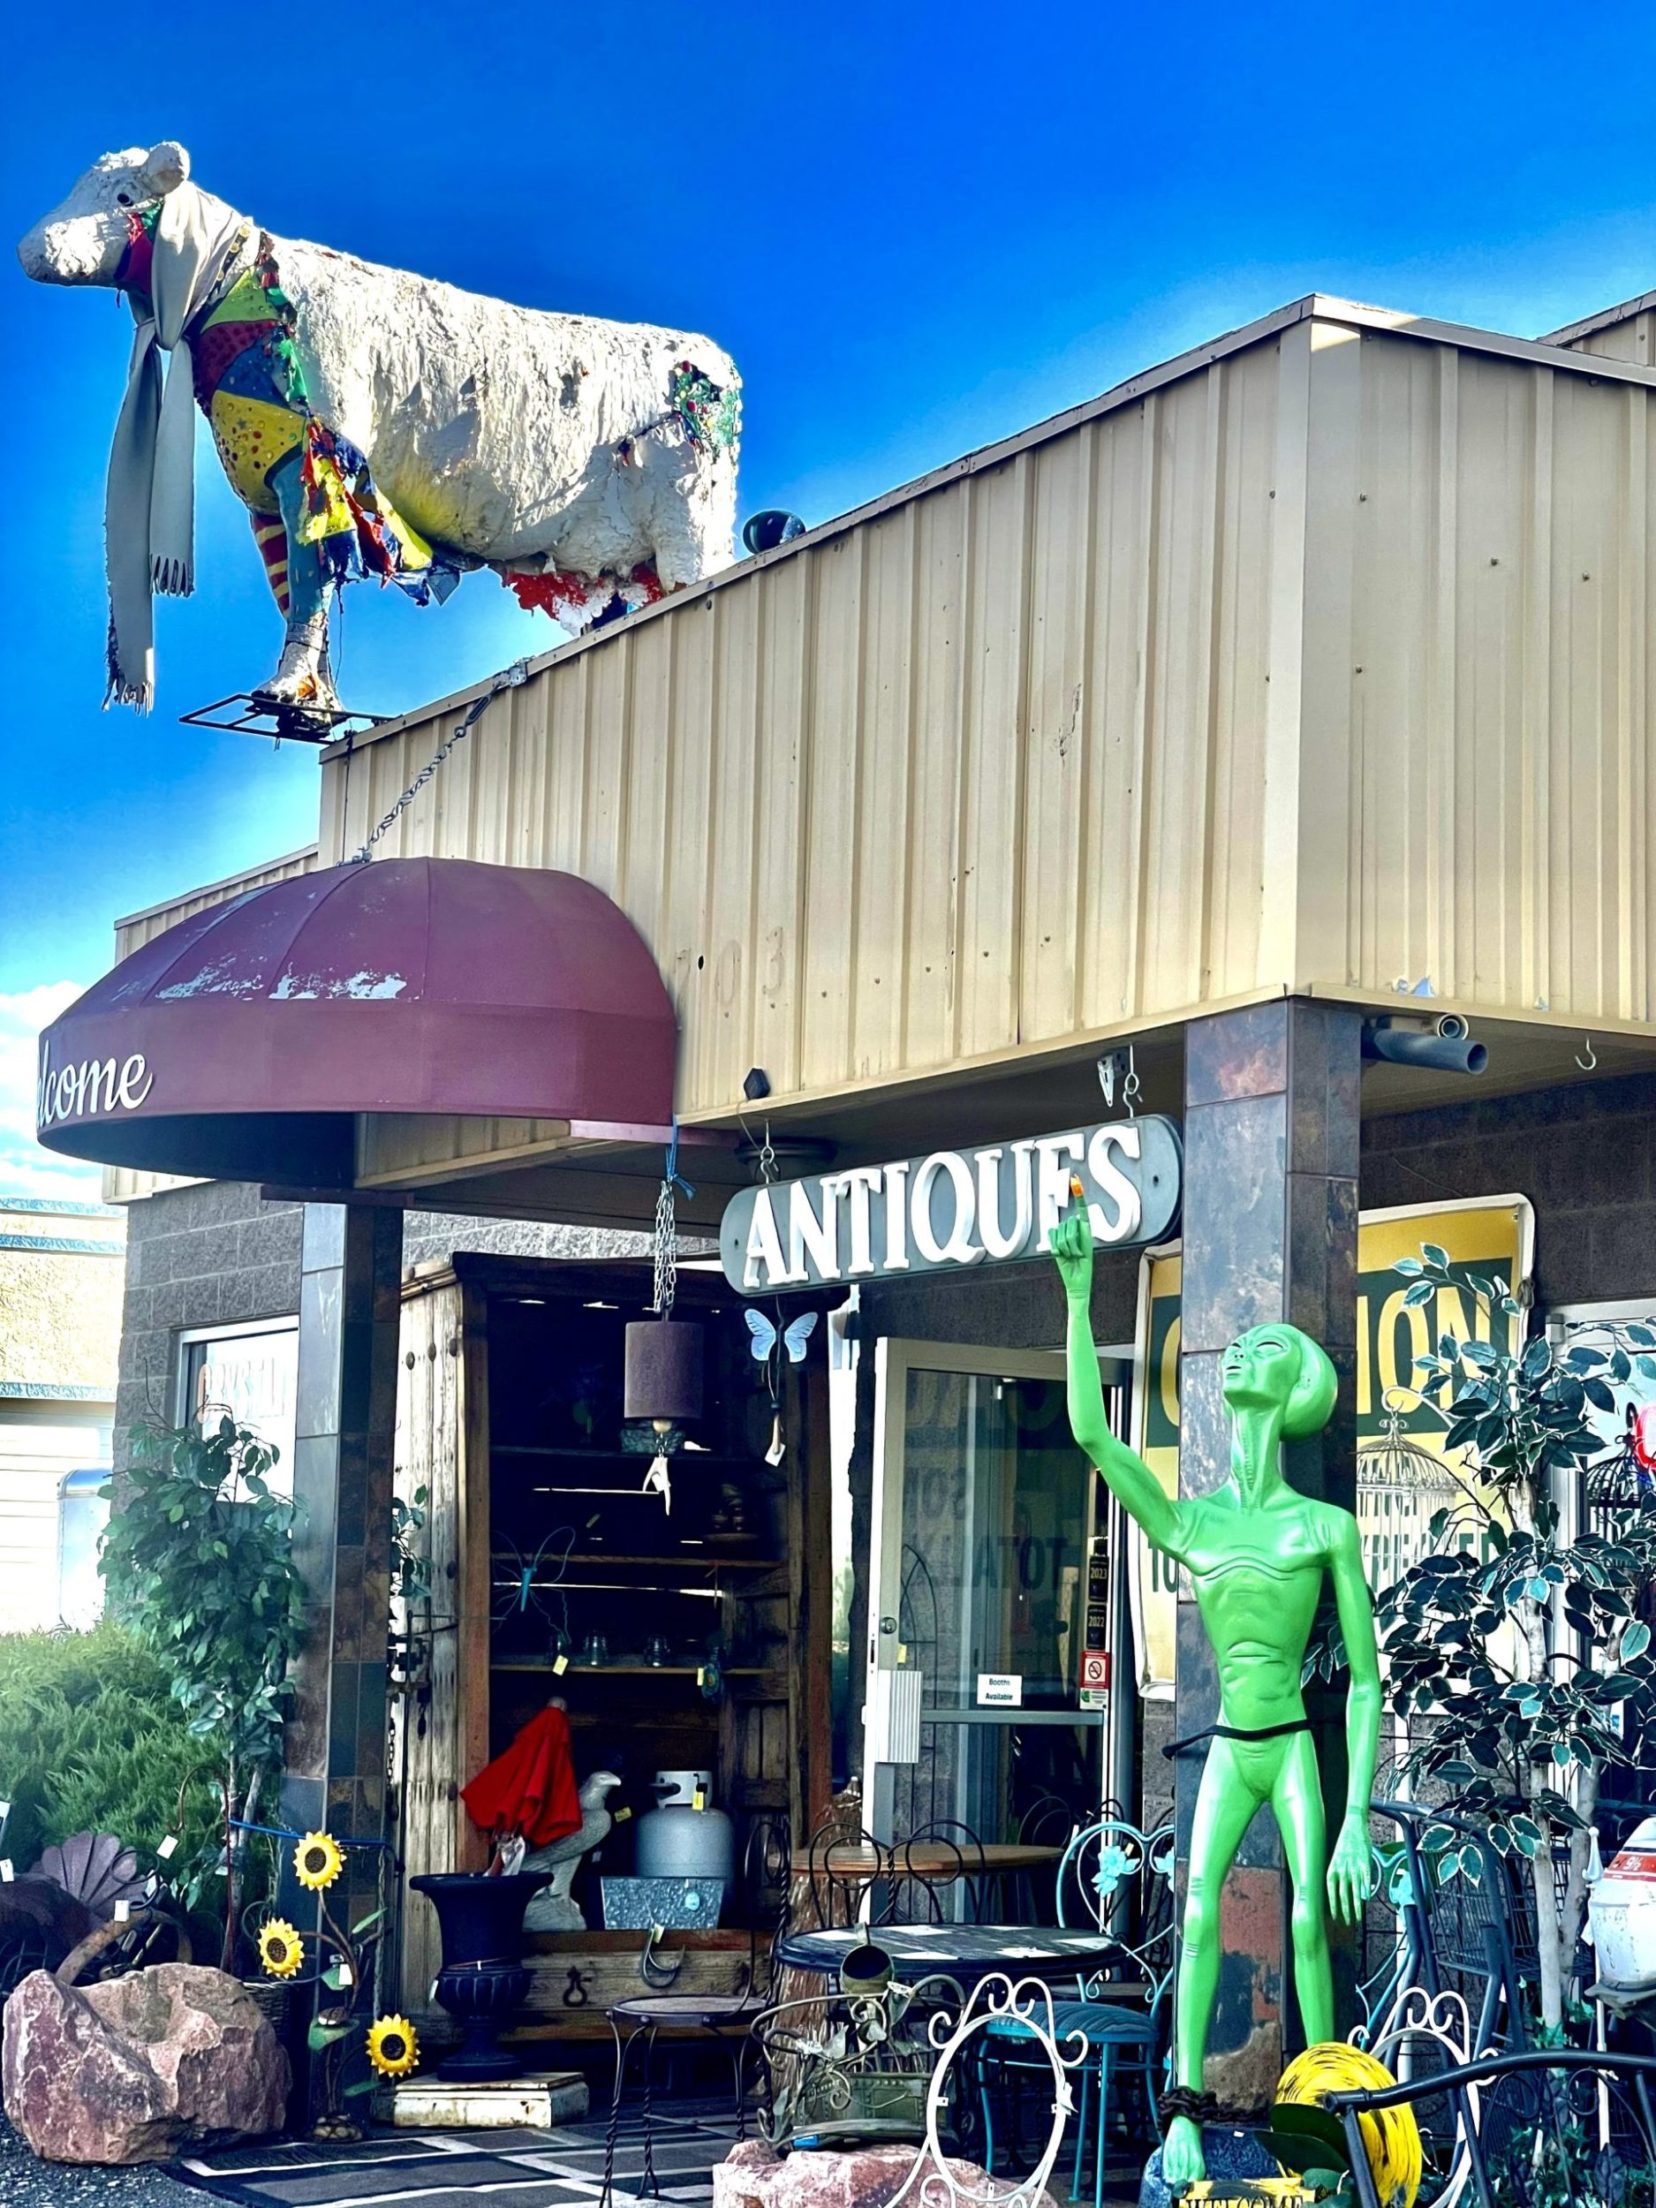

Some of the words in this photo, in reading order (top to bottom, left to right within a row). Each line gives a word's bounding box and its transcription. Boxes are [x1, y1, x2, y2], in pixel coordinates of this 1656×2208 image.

[743, 1124, 1141, 1289] ANTIQUES
[1090, 1567, 1108, 1580] 2023
[1088, 1616, 1105, 1628] 2022
